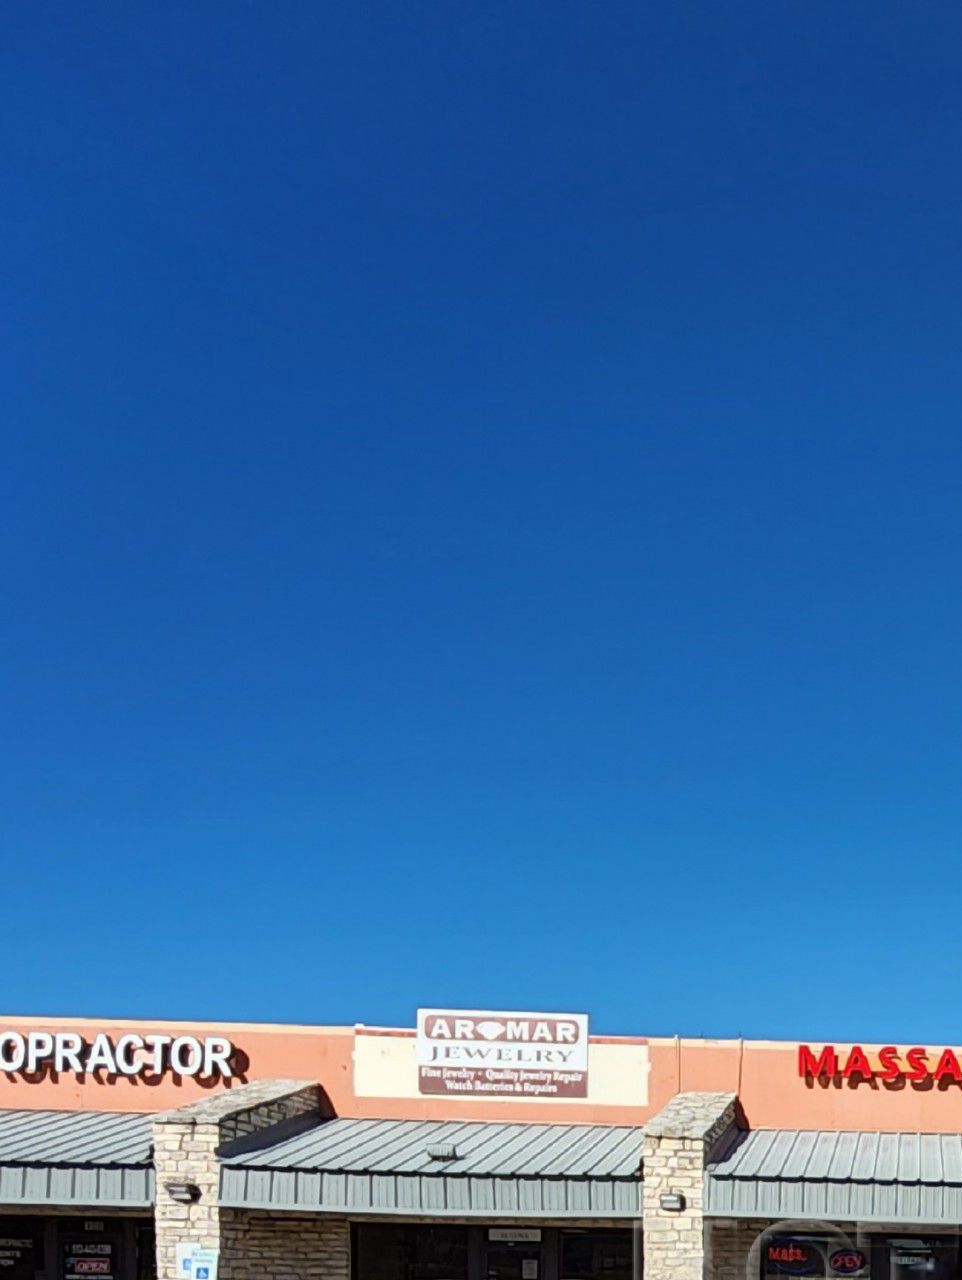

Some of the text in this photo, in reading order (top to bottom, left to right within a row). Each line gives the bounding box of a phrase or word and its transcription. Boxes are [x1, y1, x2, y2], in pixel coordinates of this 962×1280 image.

[0, 1031, 232, 1077] OPRACTOR
[430, 1046, 573, 1063] JEWELRY
[421, 1068, 442, 1078] Fine
